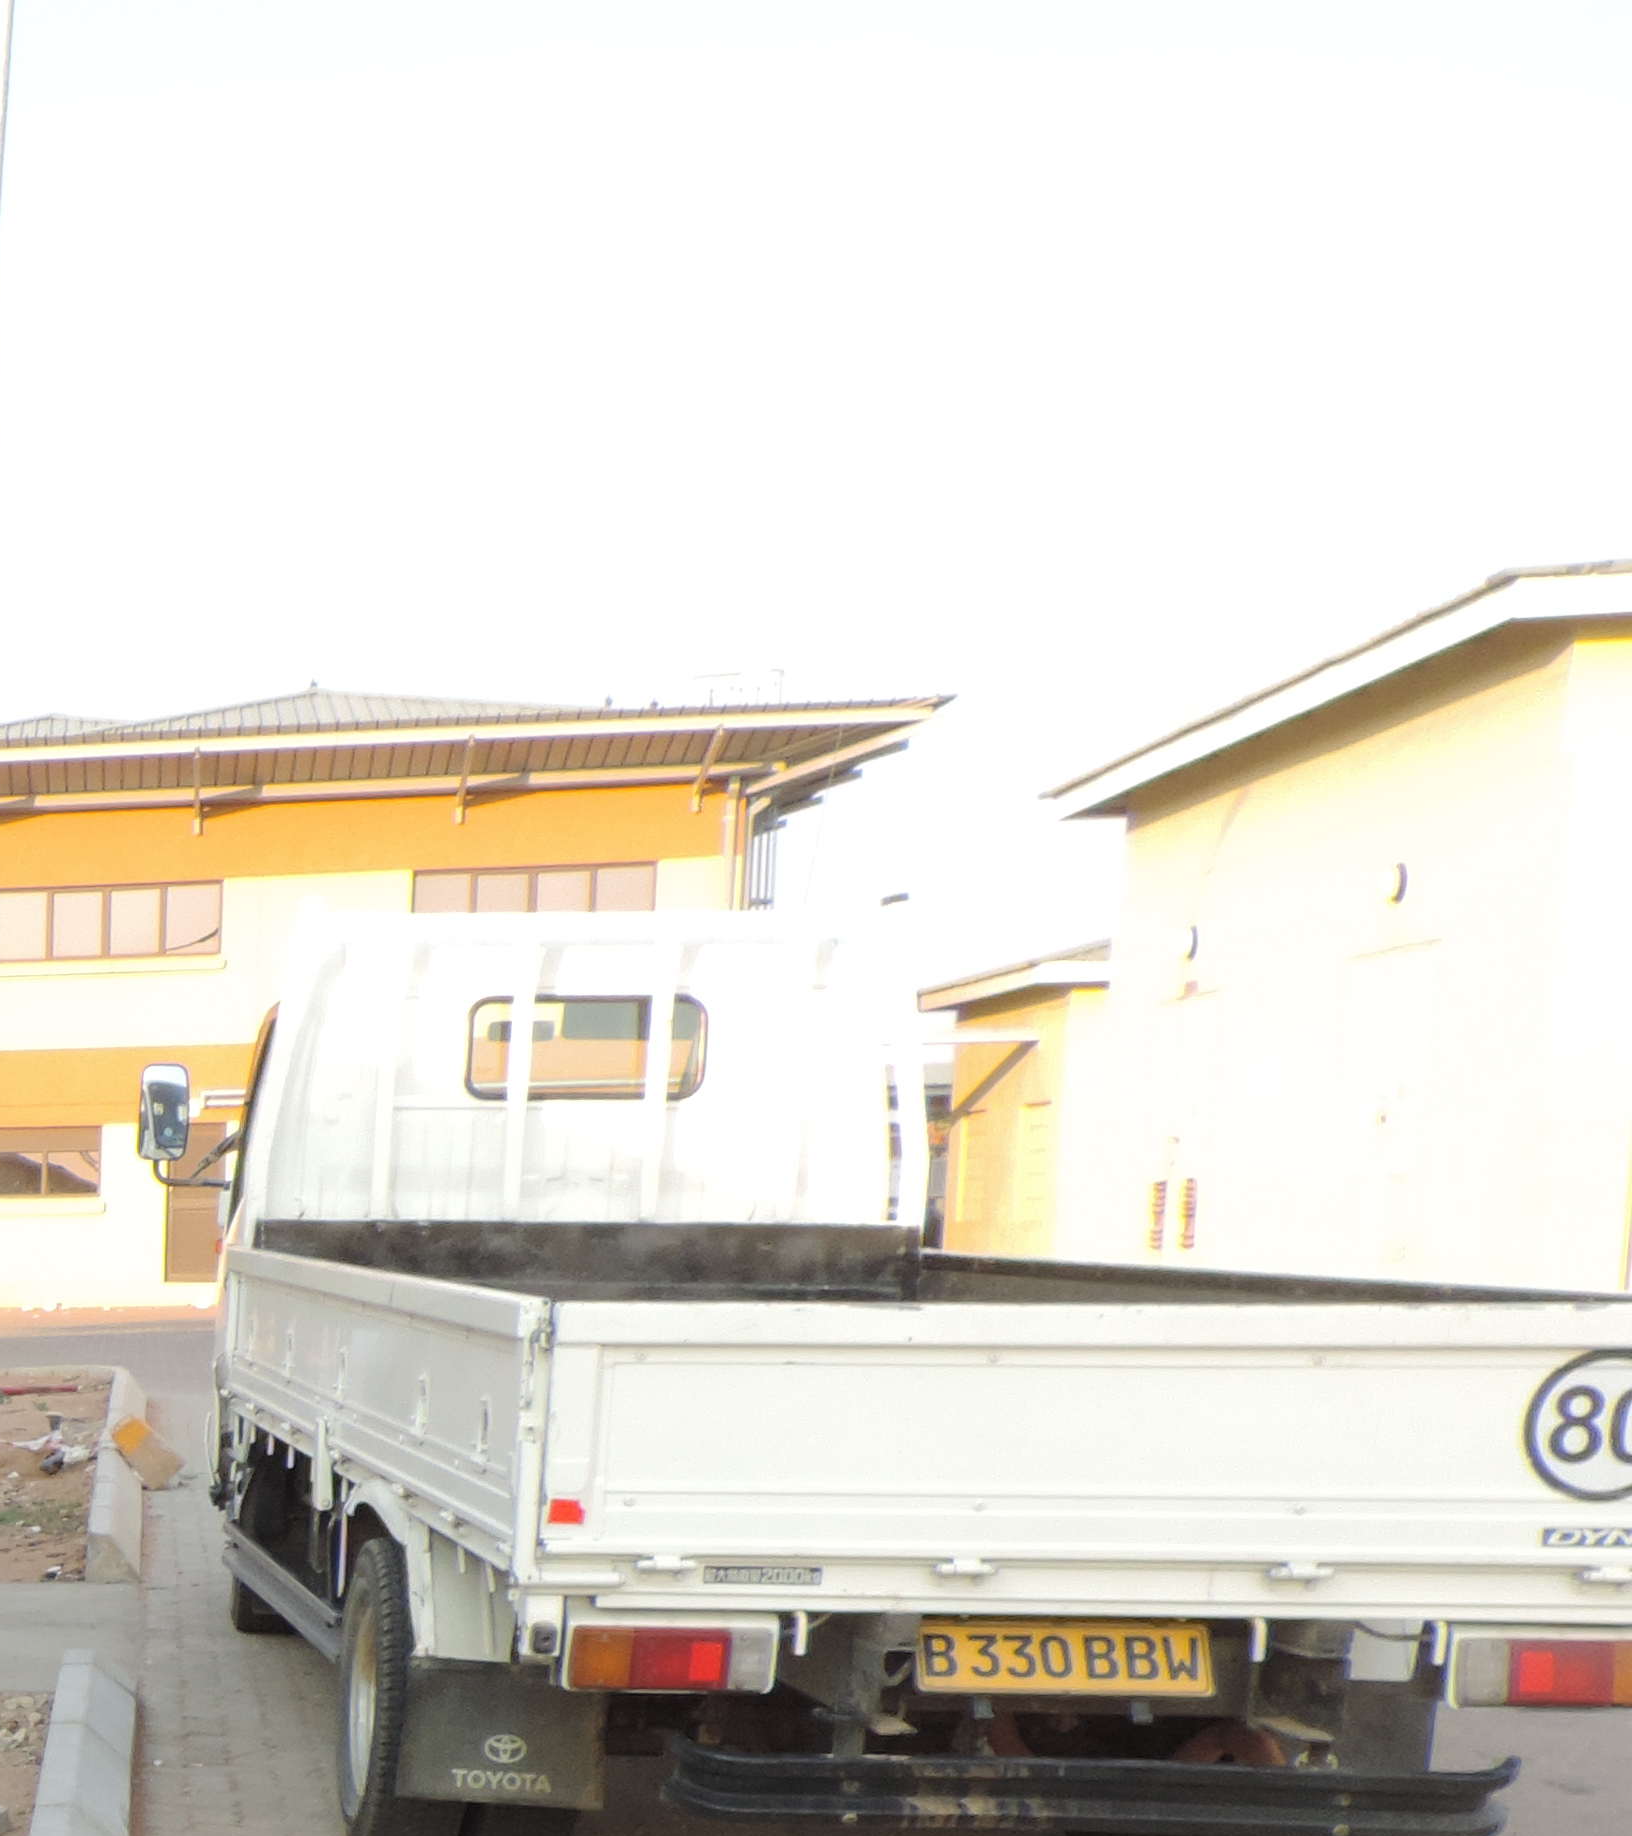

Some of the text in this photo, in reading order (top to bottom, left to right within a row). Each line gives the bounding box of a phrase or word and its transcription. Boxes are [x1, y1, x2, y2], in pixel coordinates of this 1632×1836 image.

[923, 1633, 1199, 1681] B 330 BBW
[451, 1767, 552, 1794] TOYOTA
